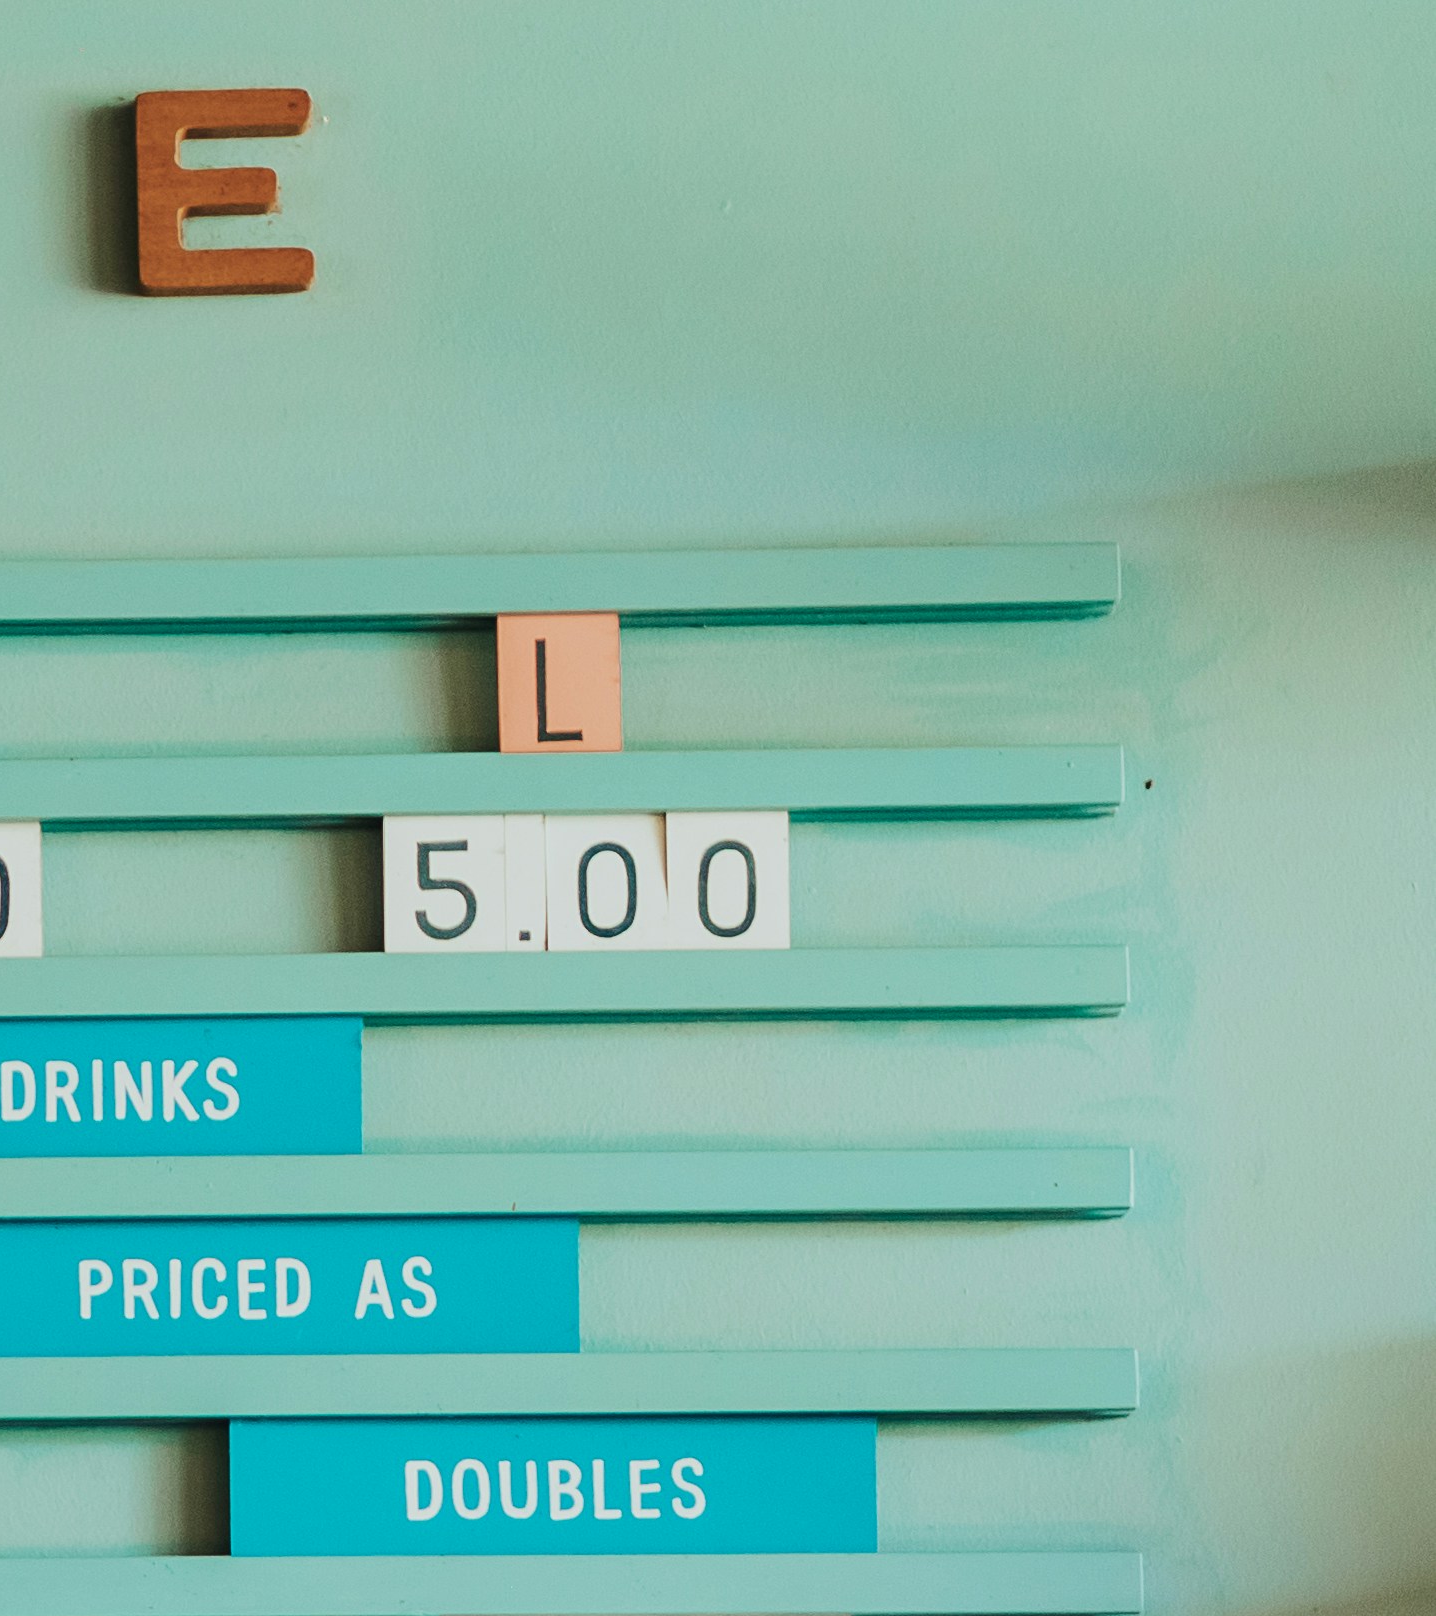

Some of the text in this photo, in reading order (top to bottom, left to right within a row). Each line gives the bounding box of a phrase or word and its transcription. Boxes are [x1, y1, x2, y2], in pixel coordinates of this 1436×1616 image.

[534, 638, 583, 744] L
[412, 839, 758, 943] 5.00
[1, 1058, 241, 1122] DRINKS
[78, 1257, 438, 1320] PRICED AS
[404, 1457, 707, 1521] DOUBLES
